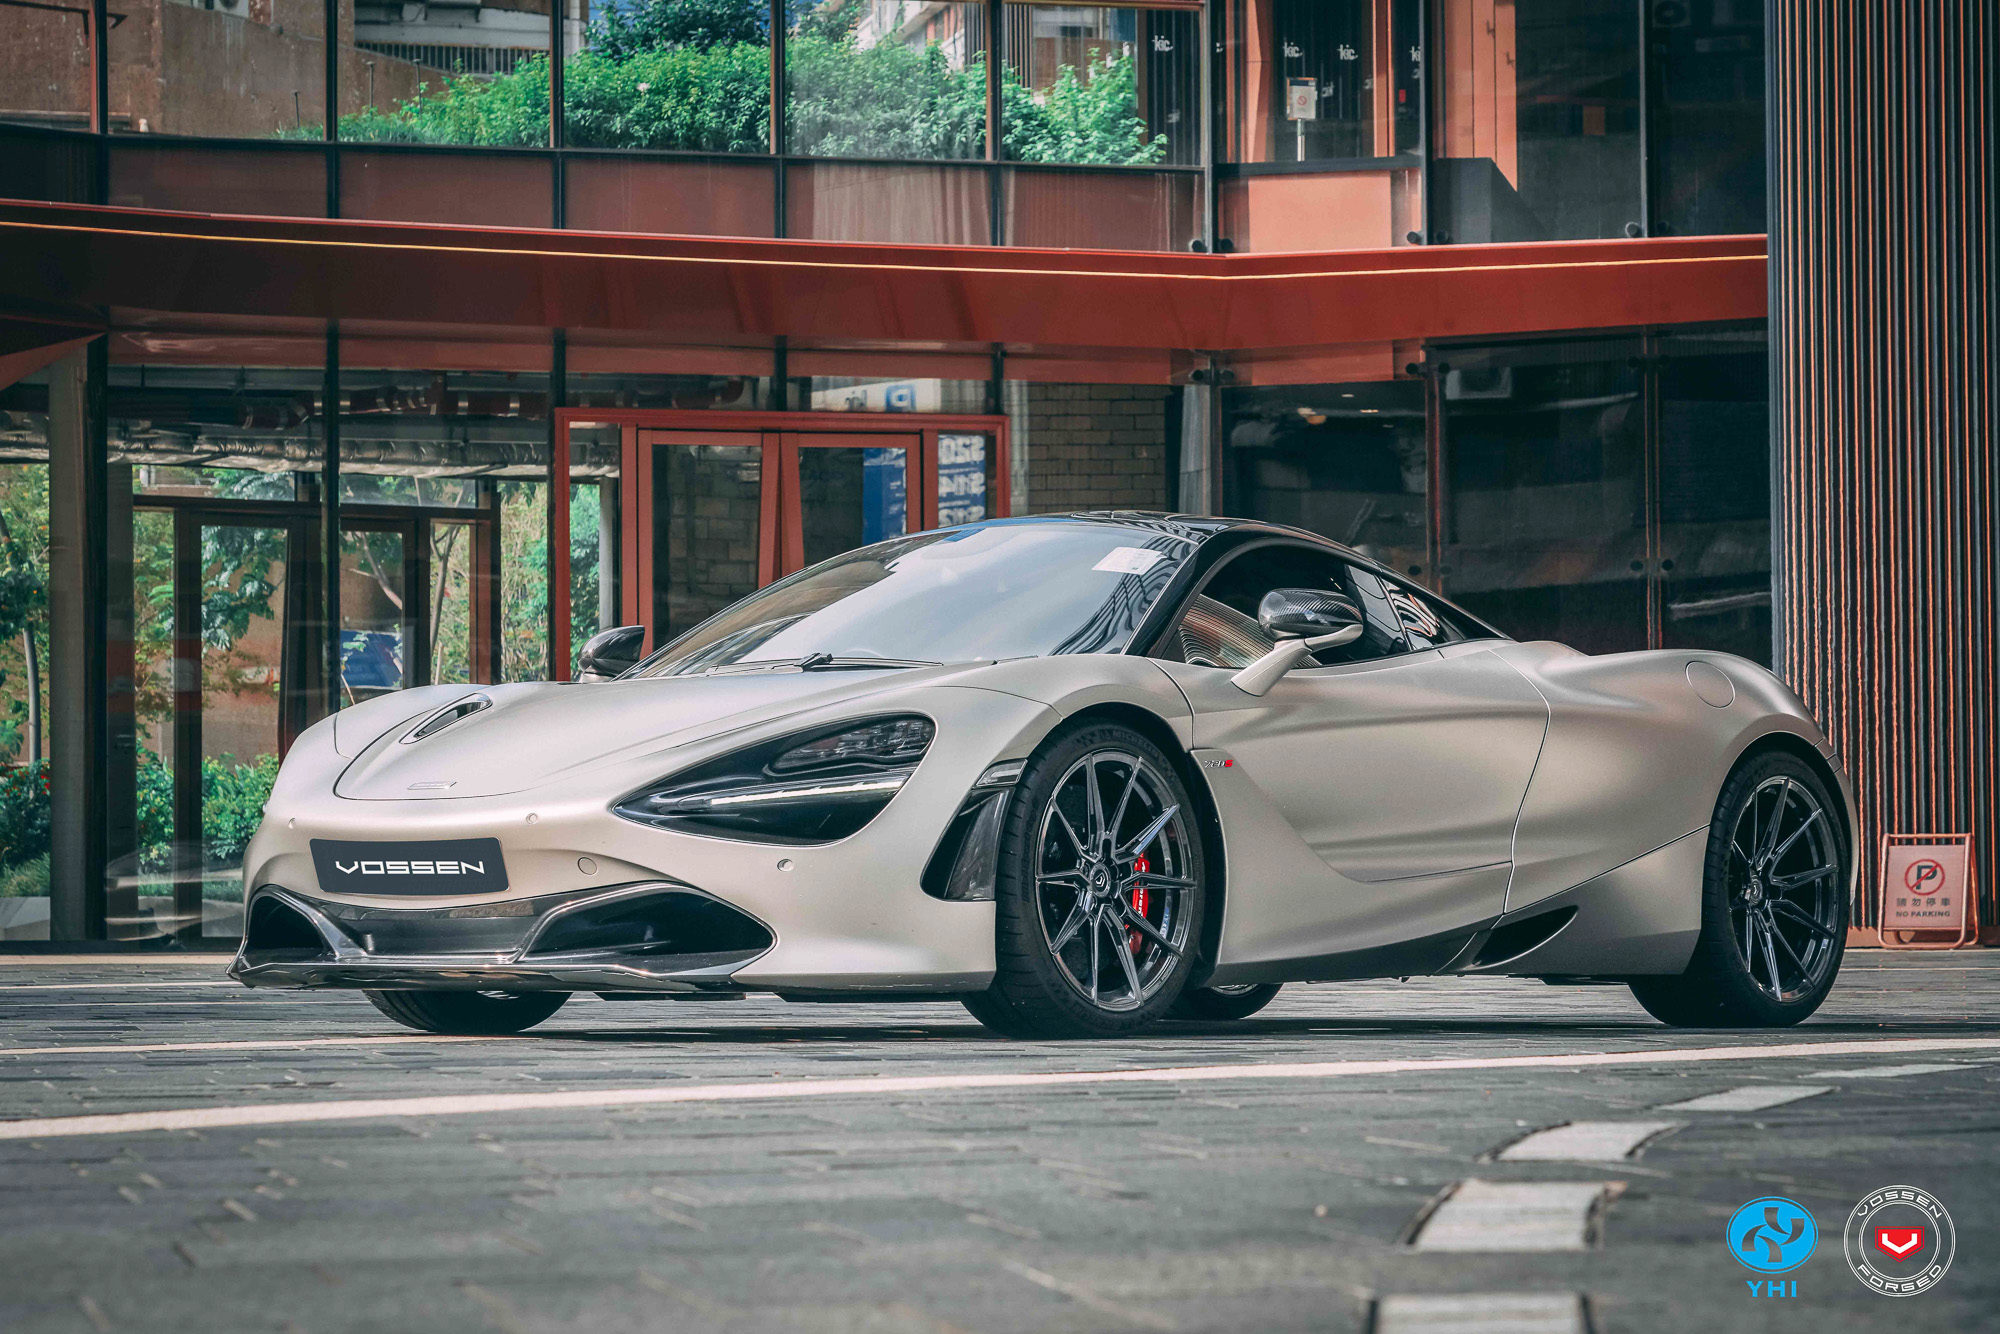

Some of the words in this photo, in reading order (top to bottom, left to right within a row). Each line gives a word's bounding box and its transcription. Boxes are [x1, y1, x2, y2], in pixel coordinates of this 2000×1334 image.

[335, 860, 485, 875] VOSSEN
[1896, 898, 1950, 907] 請勿停車
